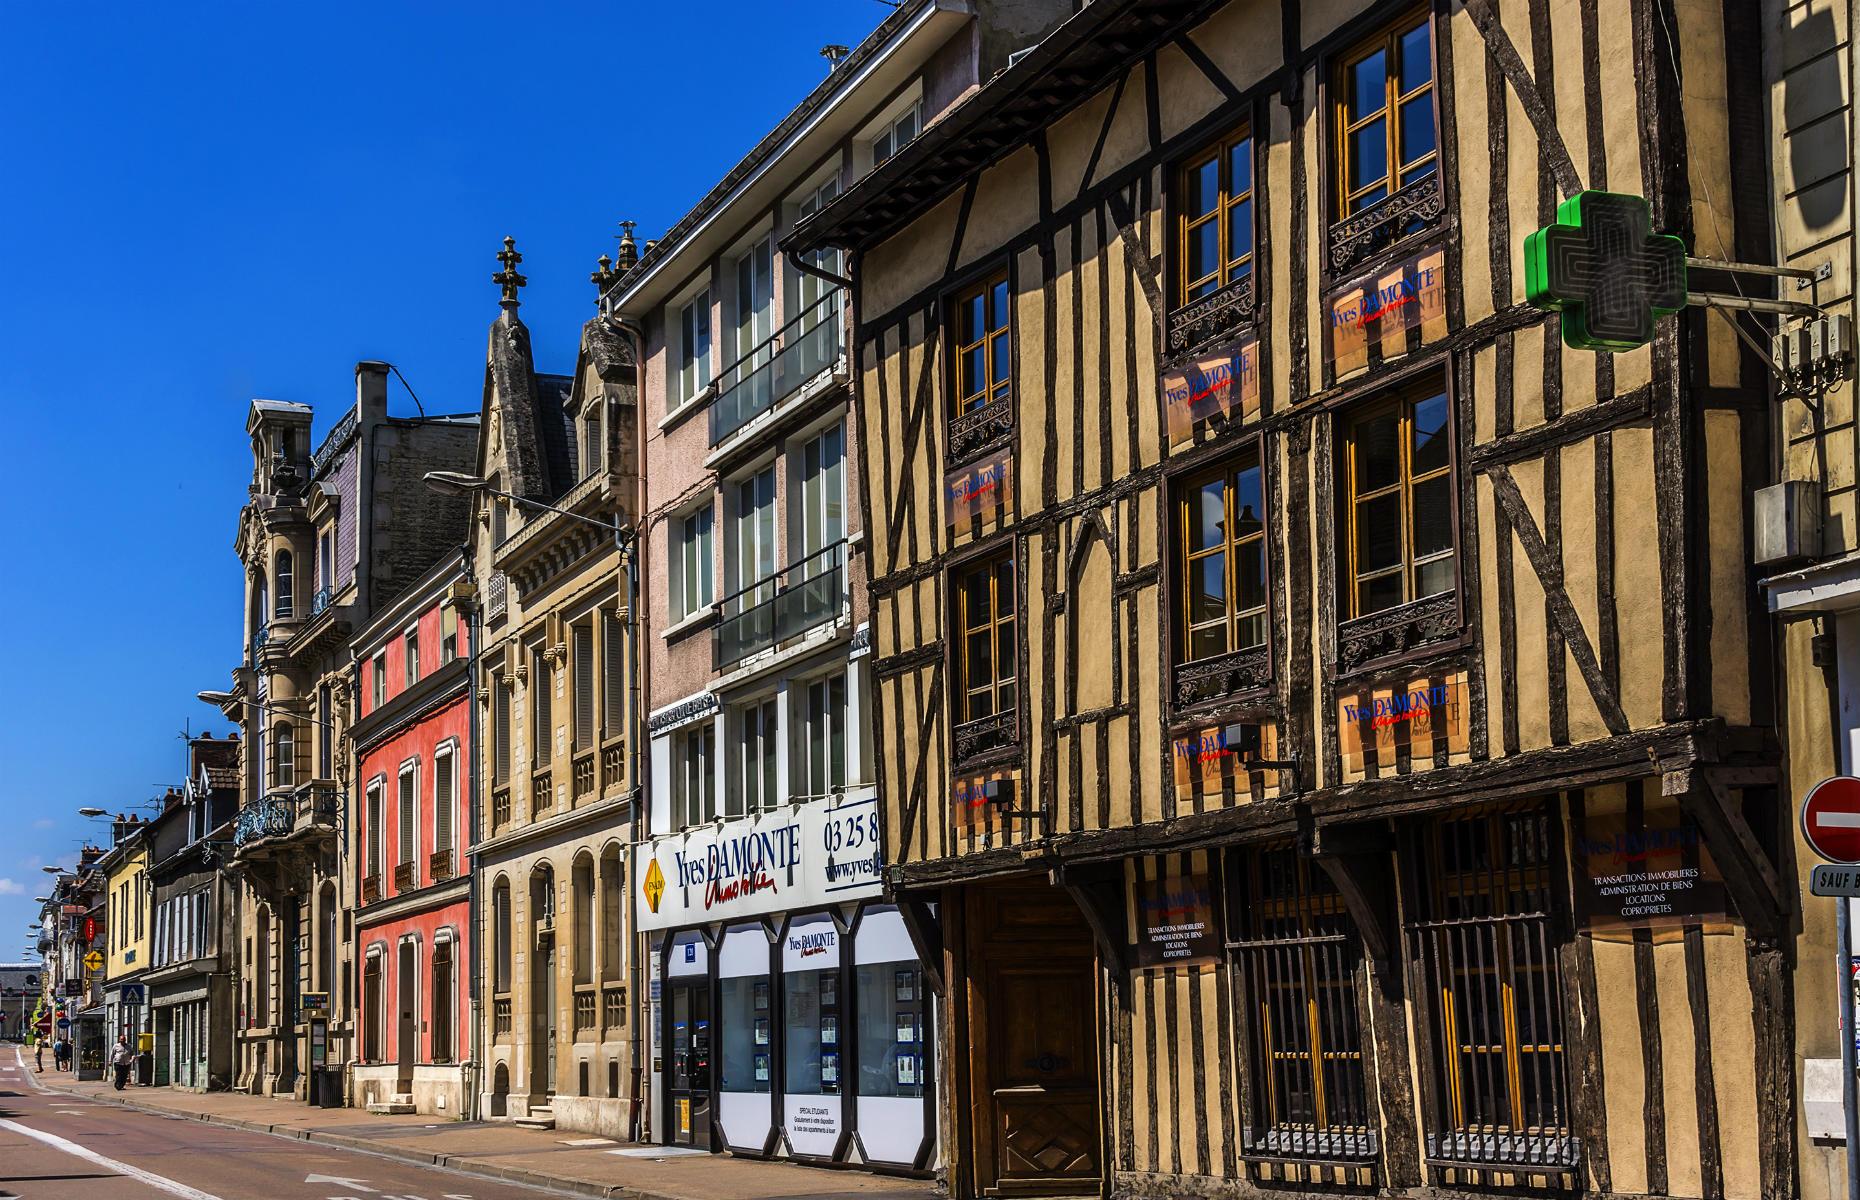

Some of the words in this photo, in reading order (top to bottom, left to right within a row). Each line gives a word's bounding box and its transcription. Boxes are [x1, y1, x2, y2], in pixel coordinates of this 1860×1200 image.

[1330, 303, 1356, 328] Yves
[1360, 267, 1434, 315] DAMONTE
[1167, 387, 1188, 405] Yves
[1344, 704, 1371, 722] Yves
[1373, 684, 1449, 717] DAMONTE
[824, 821, 842, 852] 03
[846, 814, 864, 848] 25
[675, 850, 705, 888] Yves
[707, 824, 800, 882] DAMONTE
[1594, 872, 1646, 885] TRANSACTIONS
[1648, 868, 1698, 881] IMMOBILIERES
[1820, 872, 1849, 888] SAUF
[1600, 882, 1659, 896] ADMINISTRATION
[1661, 882, 1670, 891] DE
[1673, 880, 1693, 890] BIENS
[1625, 894, 1665, 904] LOCATIONS
[1621, 904, 1671, 916] COPROPRIETES
[1148, 925, 1176, 933] TRANSACTIONS
[1177, 922, 1204, 931] IMMOBILIERES
[789, 937, 801, 950] Yves
[802, 932, 835, 949] DAMONTE
[1152, 933, 1183, 941] ADMINISTRATION
[1166, 941, 1187, 949] LOCATIONS
[1163, 949, 1191, 957] COPROPRIETES
